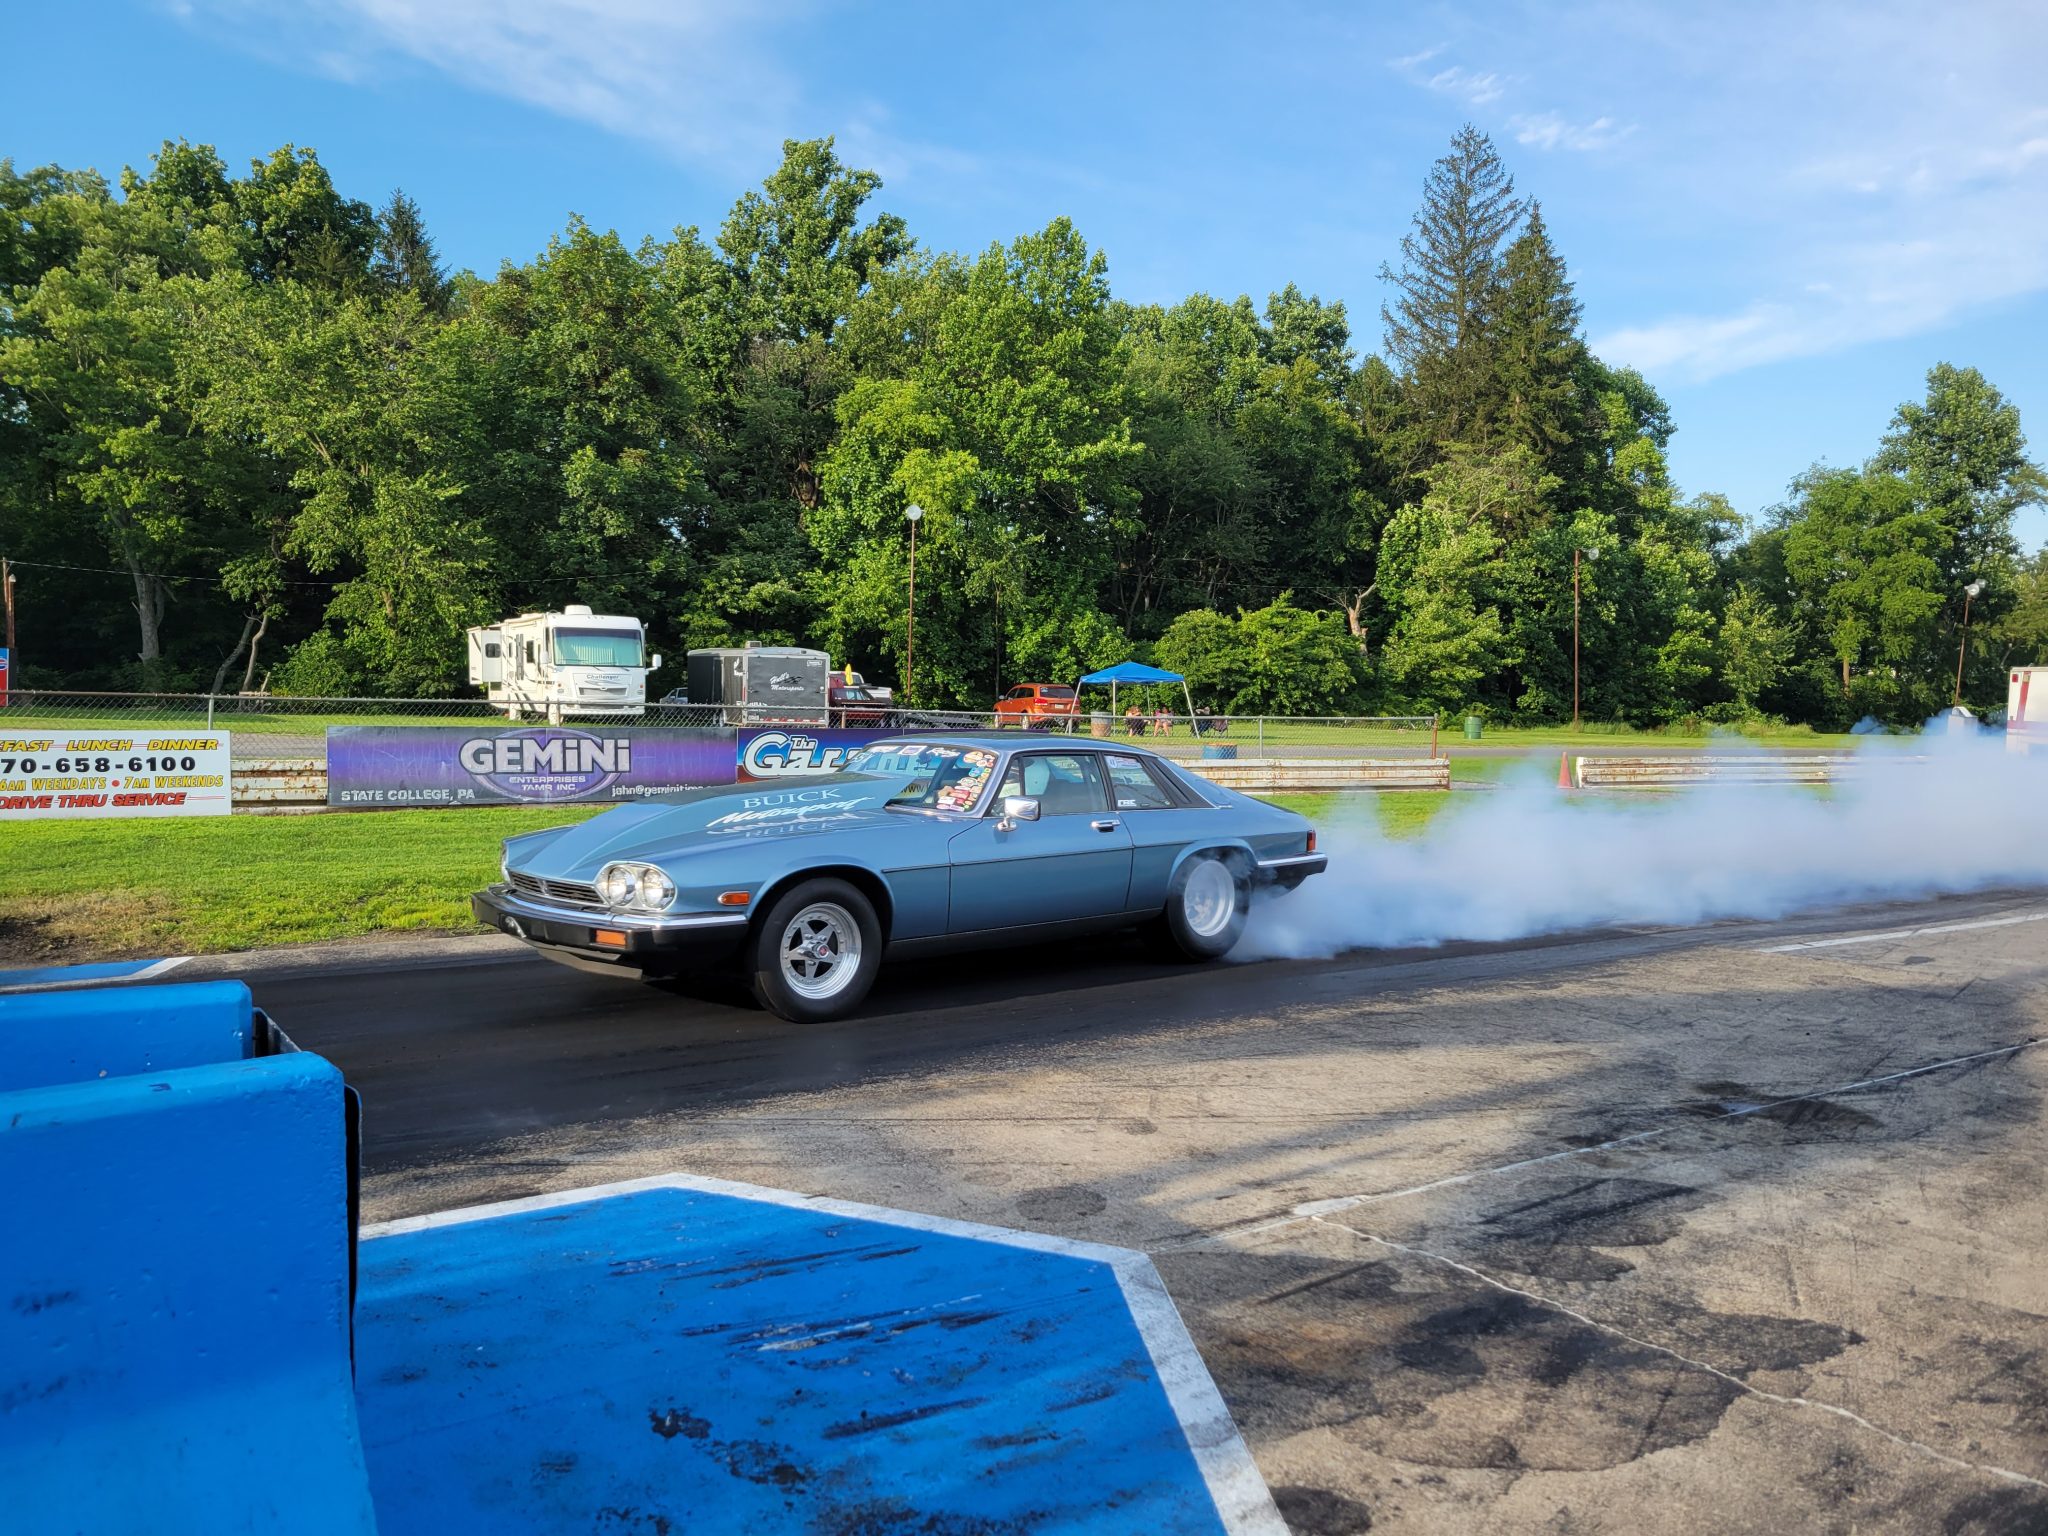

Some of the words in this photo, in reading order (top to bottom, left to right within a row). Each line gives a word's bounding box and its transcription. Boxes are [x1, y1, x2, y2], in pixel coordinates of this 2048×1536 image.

[66, 740, 133, 751] LUNCH
[147, 739, 219, 750] DINNER
[791, 736, 816, 749] The
[32, 777, 107, 791] WEEKDAYS
[124, 777, 150, 788] 7AM
[155, 775, 224, 788] WEEKENDS
[0, 795, 54, 809] DRIVE
[58, 794, 109, 808] THRU
[111, 792, 188, 807] SERVICE
[341, 790, 384, 801] STATE
[387, 789, 454, 801] COLLEGE,
[457, 789, 475, 799] PA
[743, 788, 842, 809] BUICK
